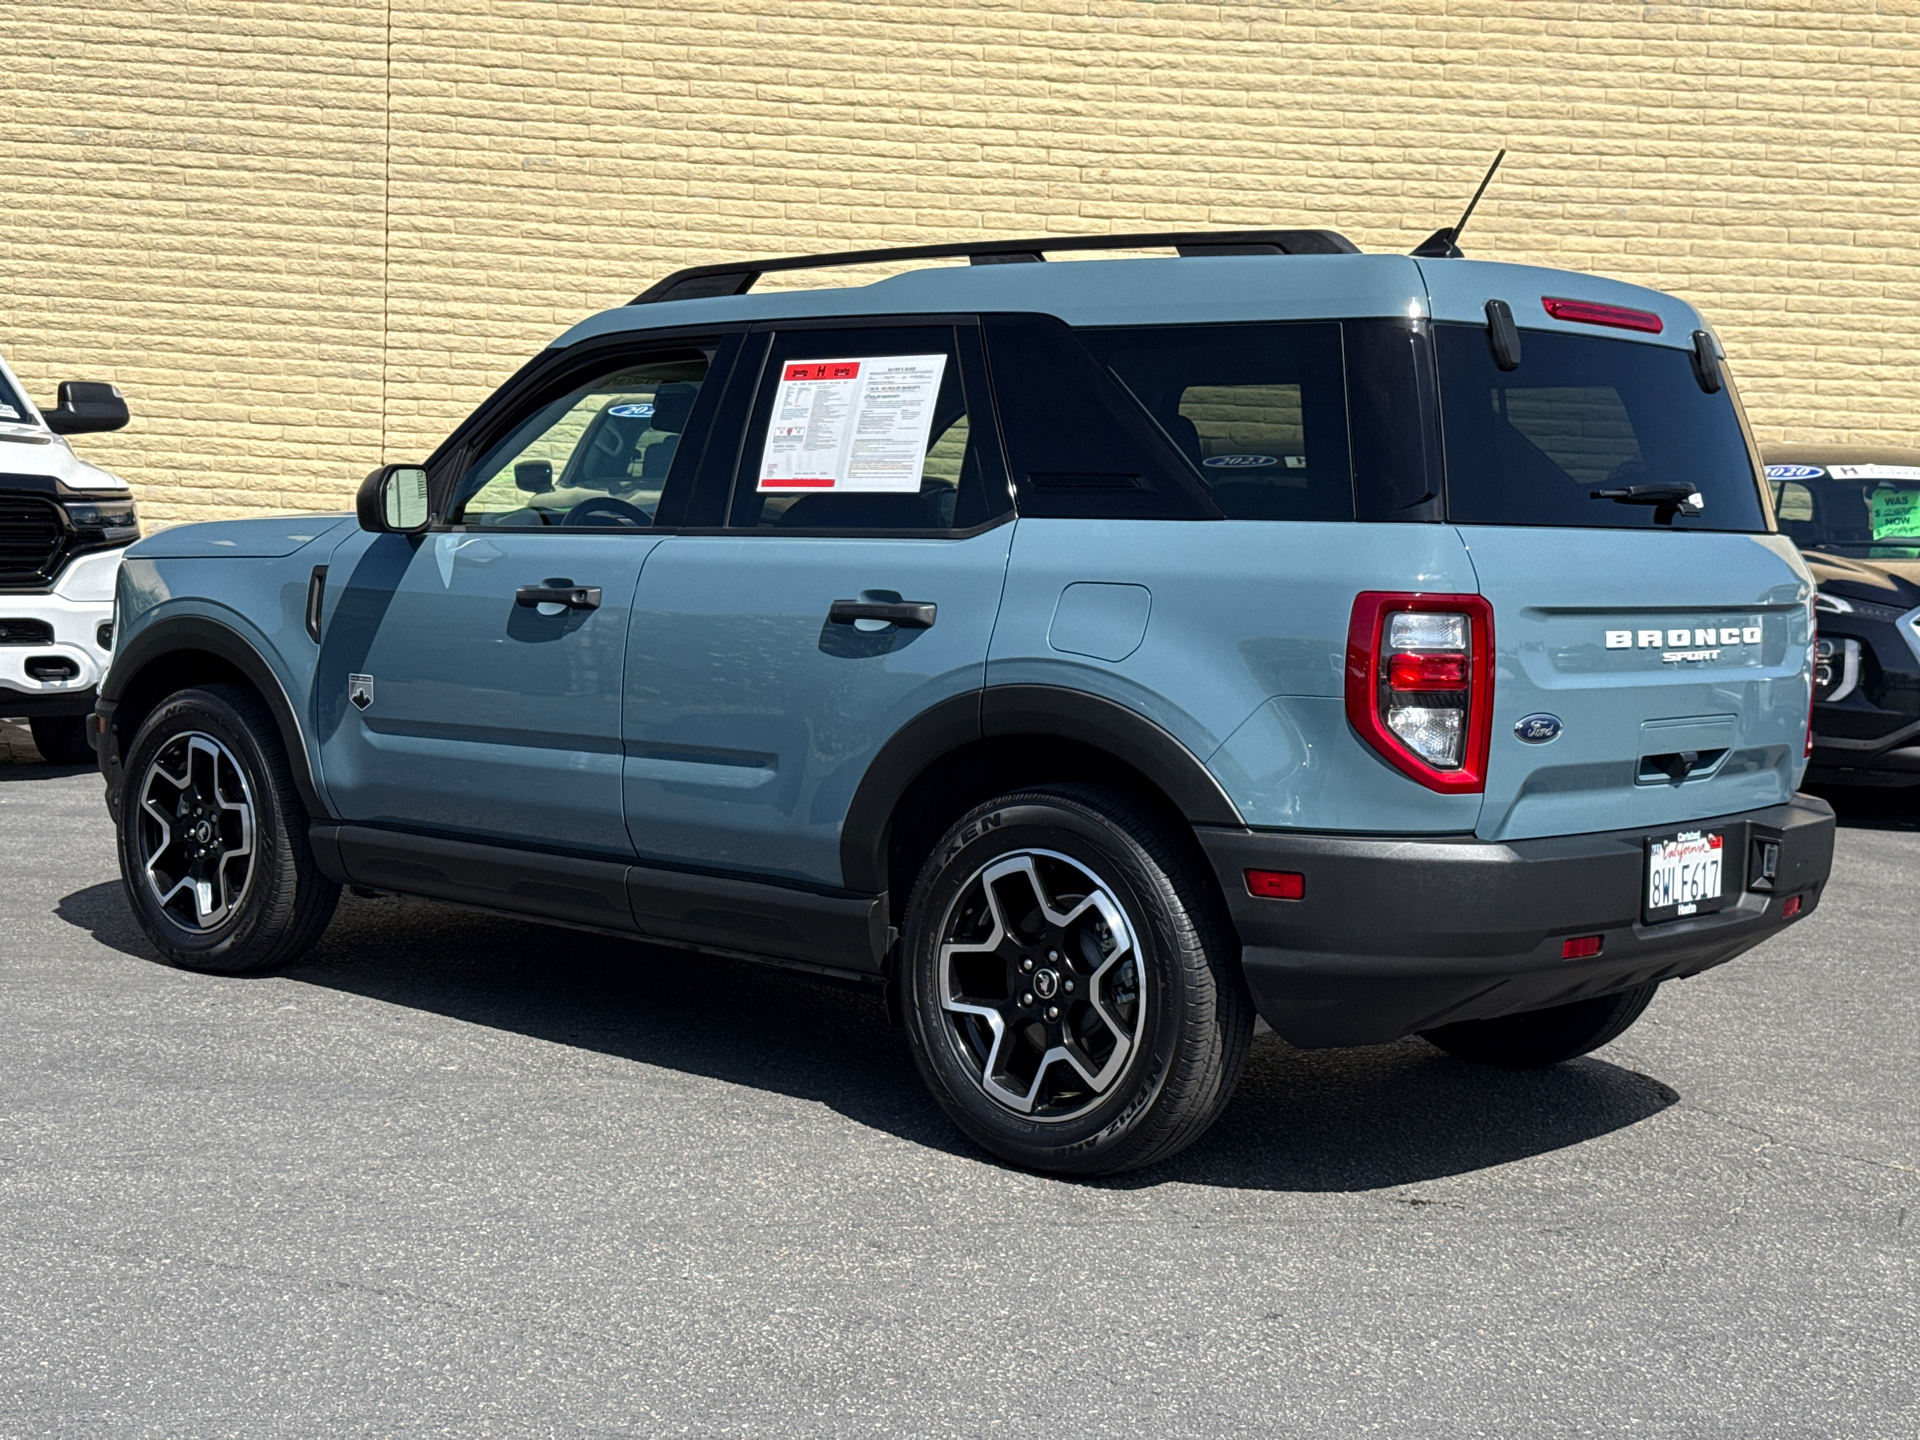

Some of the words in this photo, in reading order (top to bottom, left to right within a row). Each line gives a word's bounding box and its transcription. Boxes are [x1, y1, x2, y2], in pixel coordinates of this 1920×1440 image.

[816, 365, 827, 377] H
[623, 405, 655, 415] 202
[1884, 496, 1909, 506] WAS
[1885, 516, 1910, 525] NOW
[1605, 627, 1761, 649] BRONCO
[1662, 650, 1721, 662] SPORT
[1527, 719, 1555, 738] Ford
[1663, 842, 1711, 863] California
[1652, 859, 1719, 907] 8WLF617
